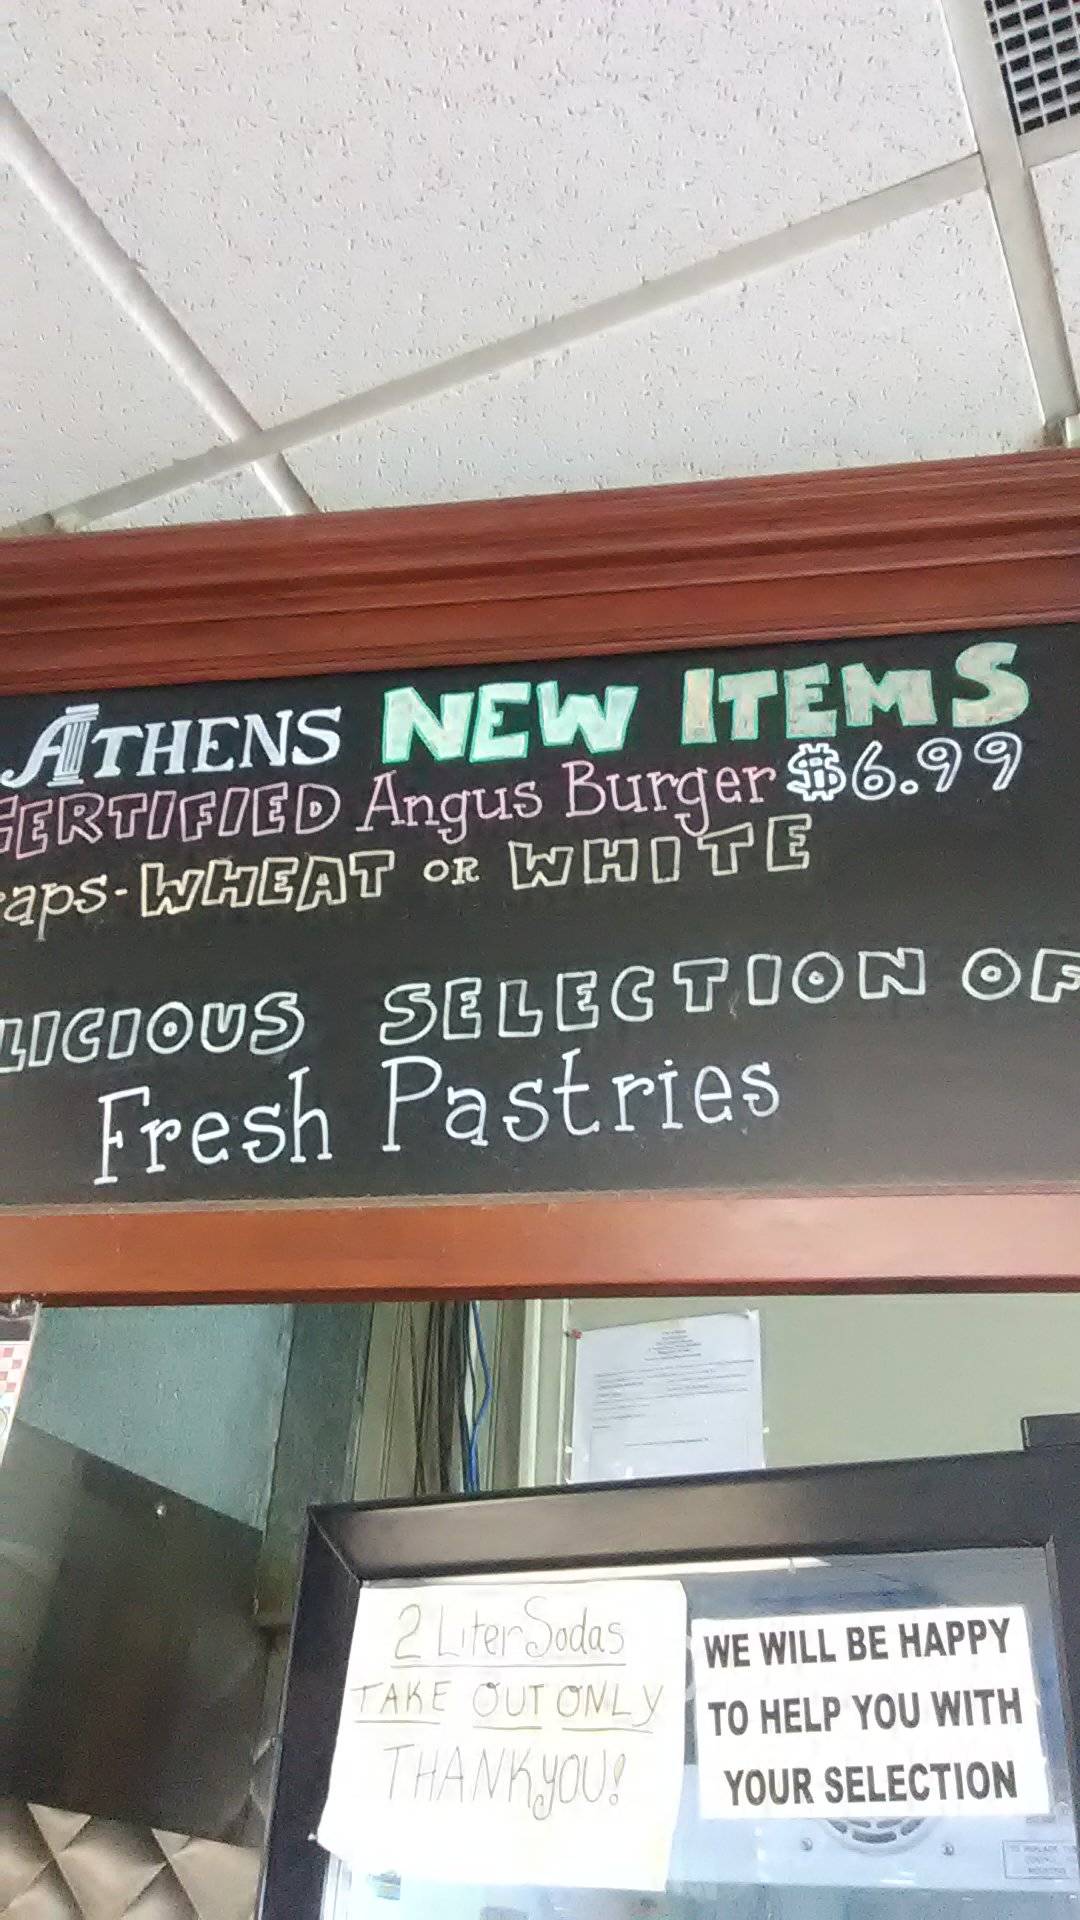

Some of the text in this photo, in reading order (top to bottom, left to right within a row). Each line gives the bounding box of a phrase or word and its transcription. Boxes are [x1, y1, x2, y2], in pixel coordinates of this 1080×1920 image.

[1, 642, 1030, 788] ATHENS NEW ITEMS
[356, 769, 543, 844] Angus
[562, 760, 776, 837] Burger
[787, 731, 1022, 801] $6.99
[0, 874, 128, 941] aps-
[141, 850, 395, 917] WHEAT
[509, 814, 812, 890] WHITE
[0, 947, 1080, 1074] LICIOUS SELECTION OF
[94, 1048, 780, 1185] Fresh Pastries
[394, 1596, 625, 1660] 2 Liter Sodas
[704, 1618, 1011, 1669] WE WILL BE HAPPY
[351, 1680, 452, 1714] TAKE
[472, 1681, 545, 1717] OUT
[708, 1688, 1023, 1736] TO HELP YOU WITH
[724, 1760, 1018, 1806] YOUR SELECTION
